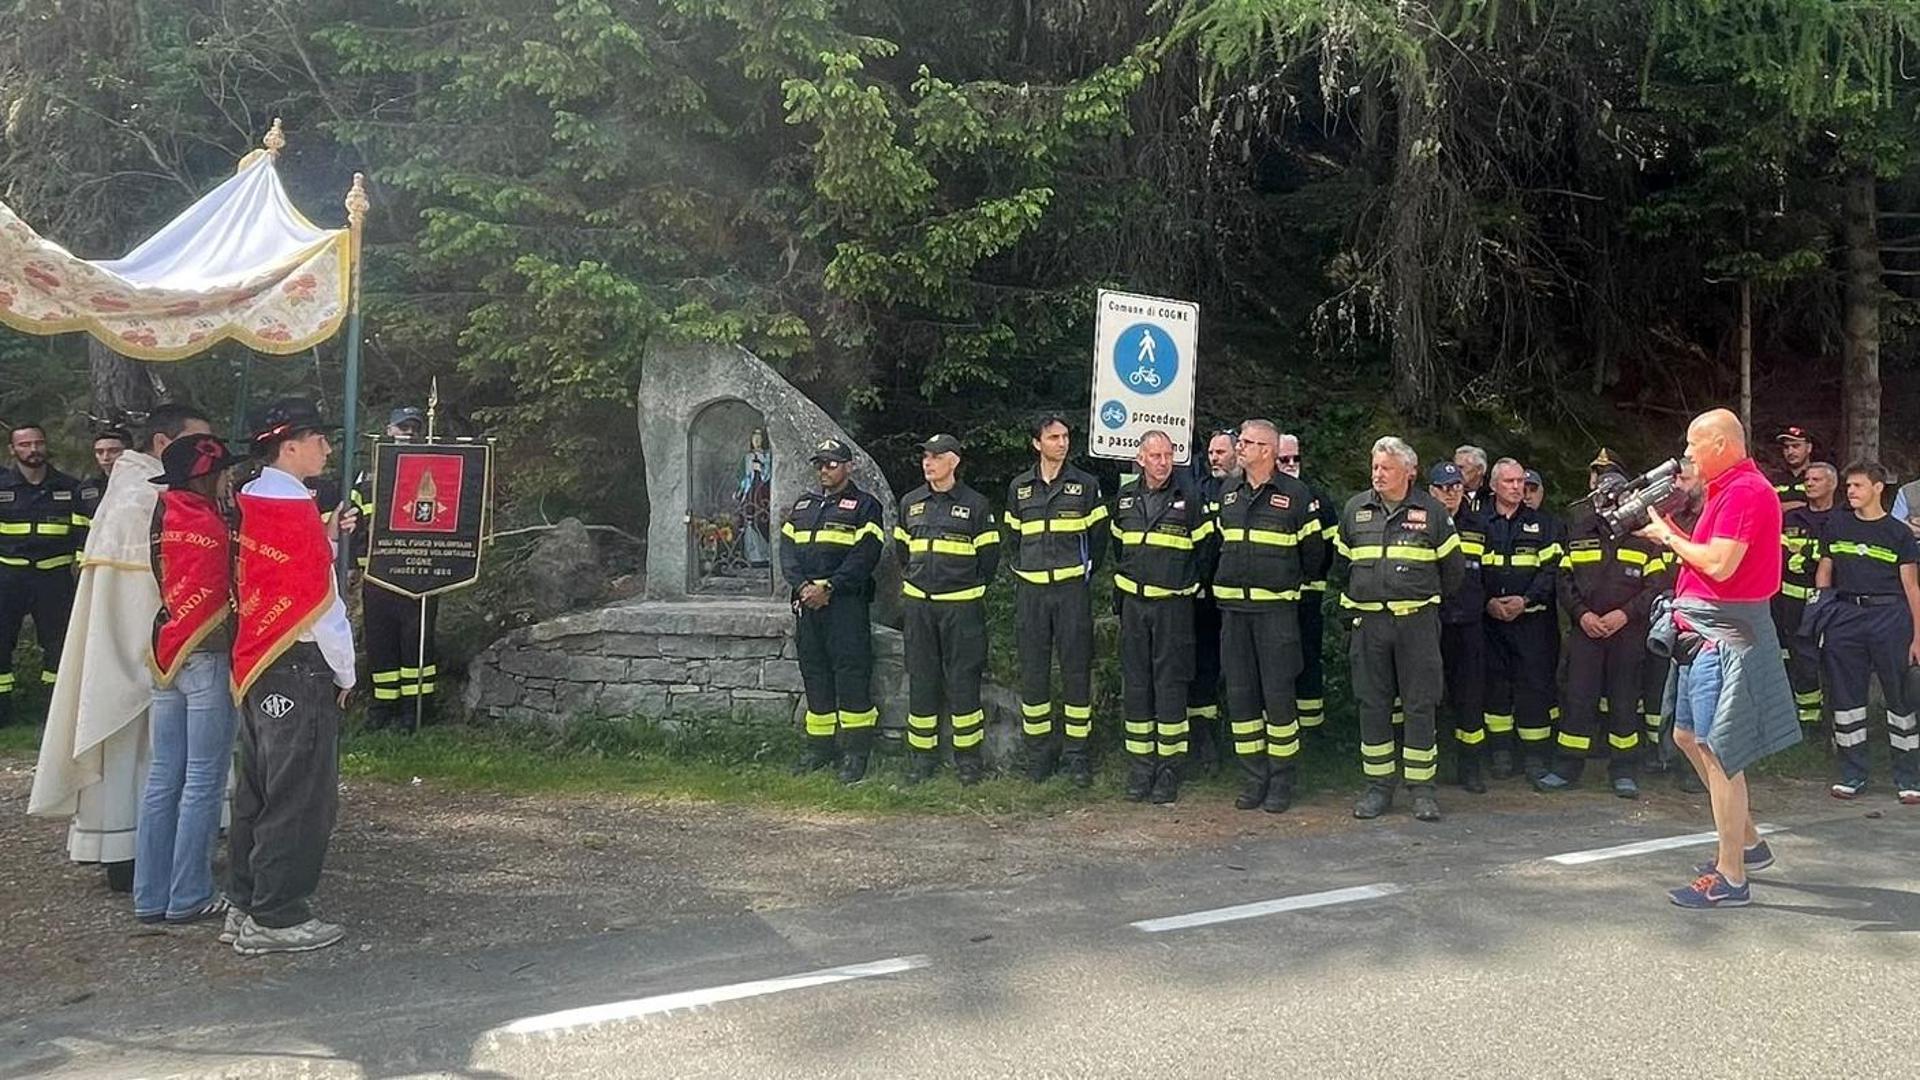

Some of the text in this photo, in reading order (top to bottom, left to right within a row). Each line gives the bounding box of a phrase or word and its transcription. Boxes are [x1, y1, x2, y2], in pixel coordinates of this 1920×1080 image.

[1108, 300, 1188, 322] Comune di COGNE
[1132, 410, 1187, 427] procedere
[1097, 434, 1140, 449] a passo
[185, 532, 219, 549] 2007
[258, 543, 290, 564] 2007
